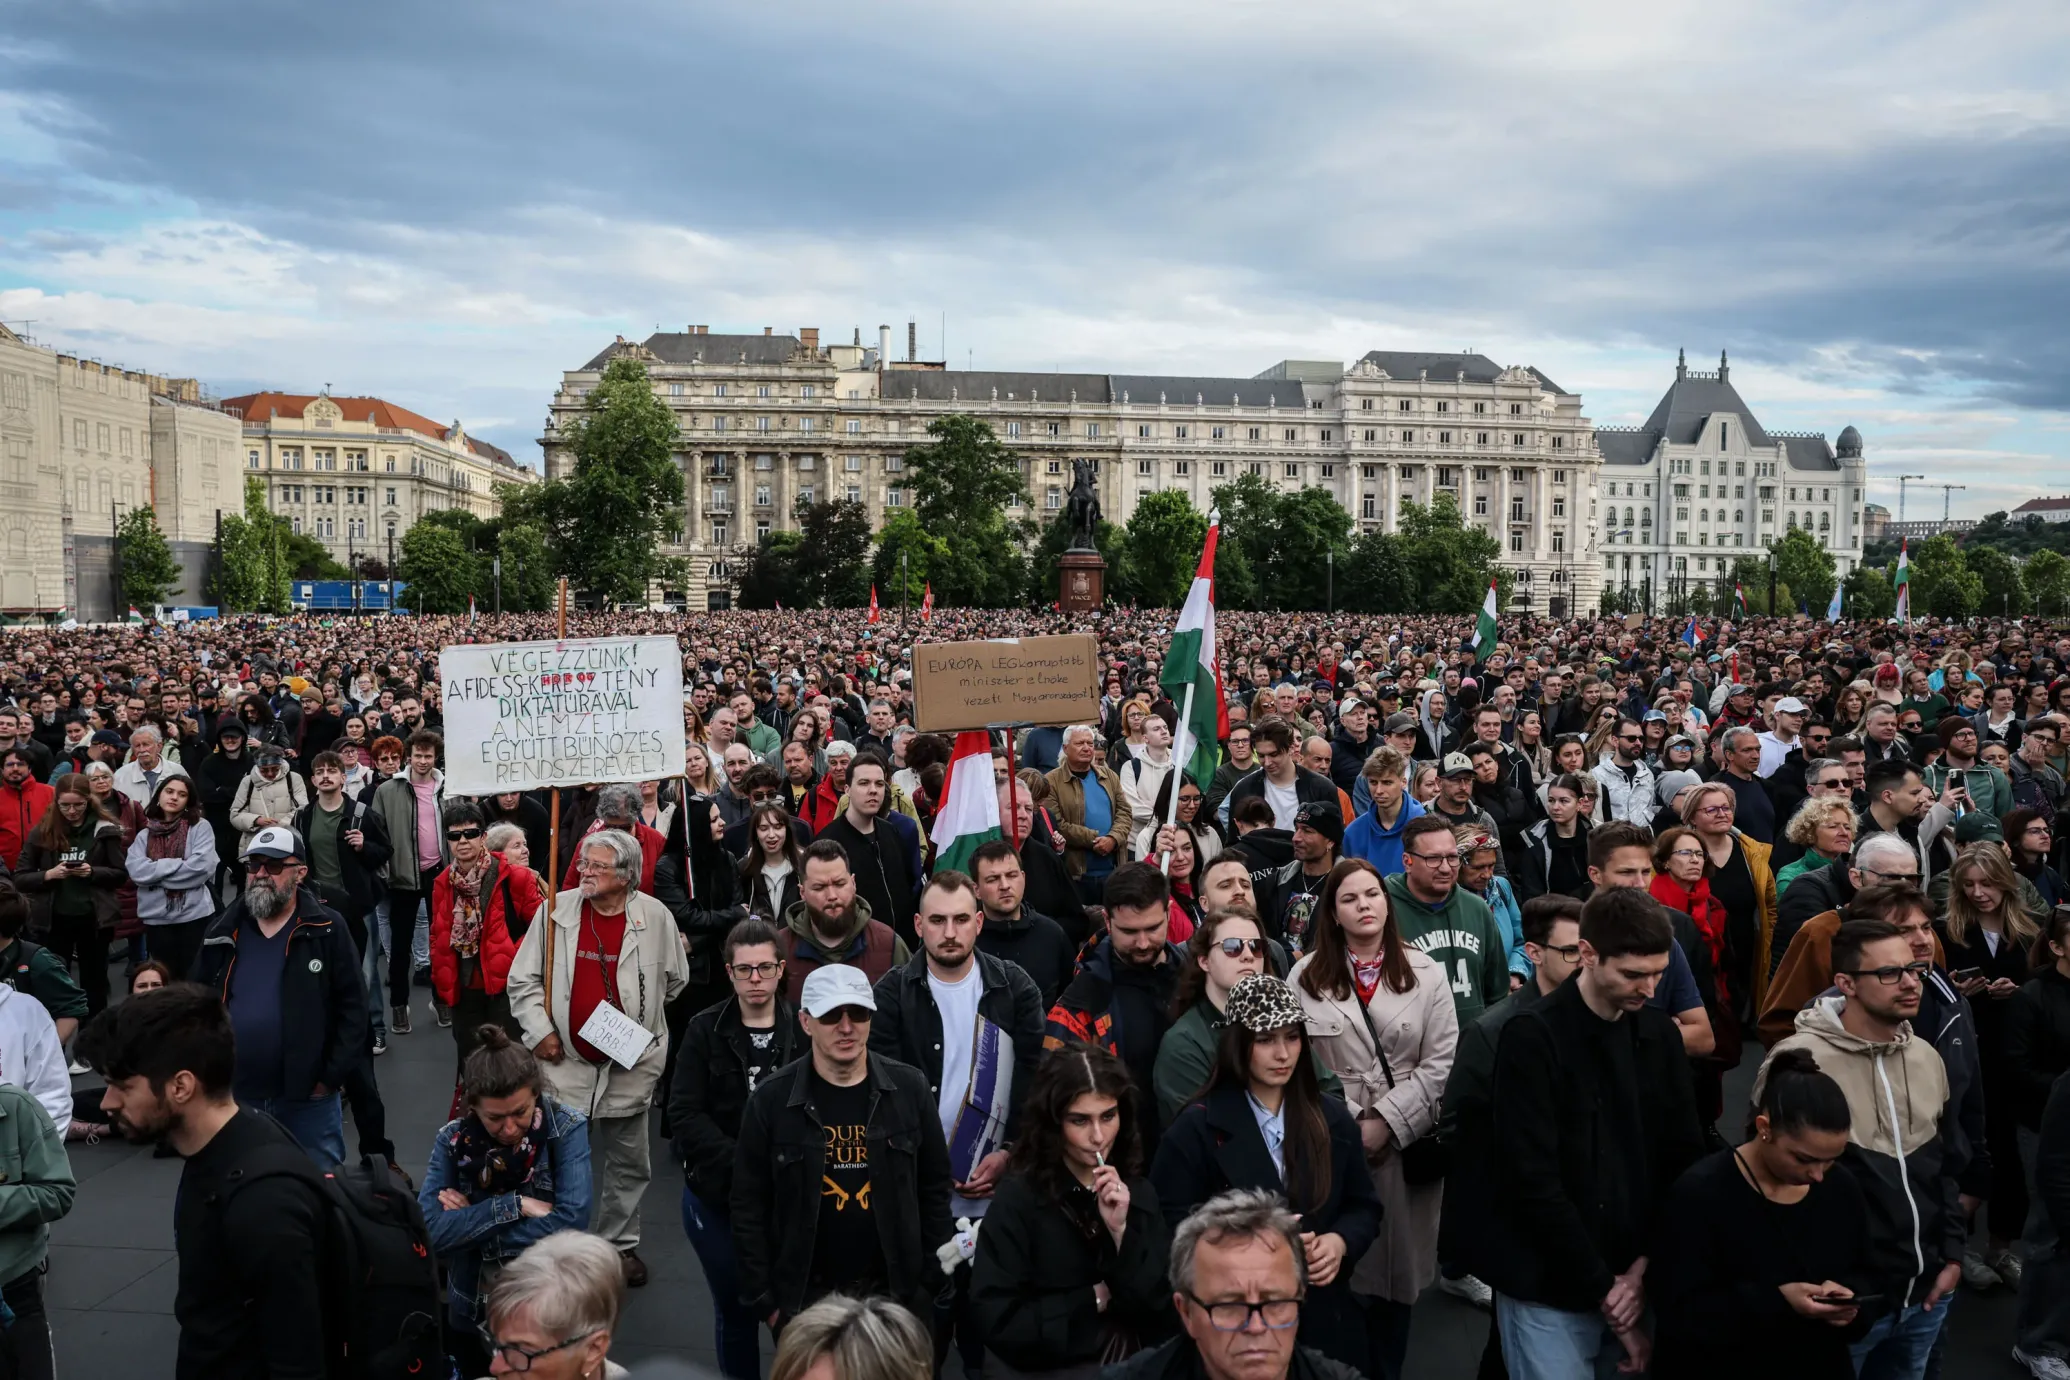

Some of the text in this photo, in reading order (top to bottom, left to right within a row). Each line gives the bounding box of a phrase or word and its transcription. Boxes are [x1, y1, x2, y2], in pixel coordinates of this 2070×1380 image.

[490, 643, 638, 673] VÉGEZZÜNK!
[928, 656, 983, 673] EURÓPA
[491, 711, 629, 741] A NEMZETI
[1436, 958, 1472, 998] 4
[600, 1010, 635, 1041] SOHA
